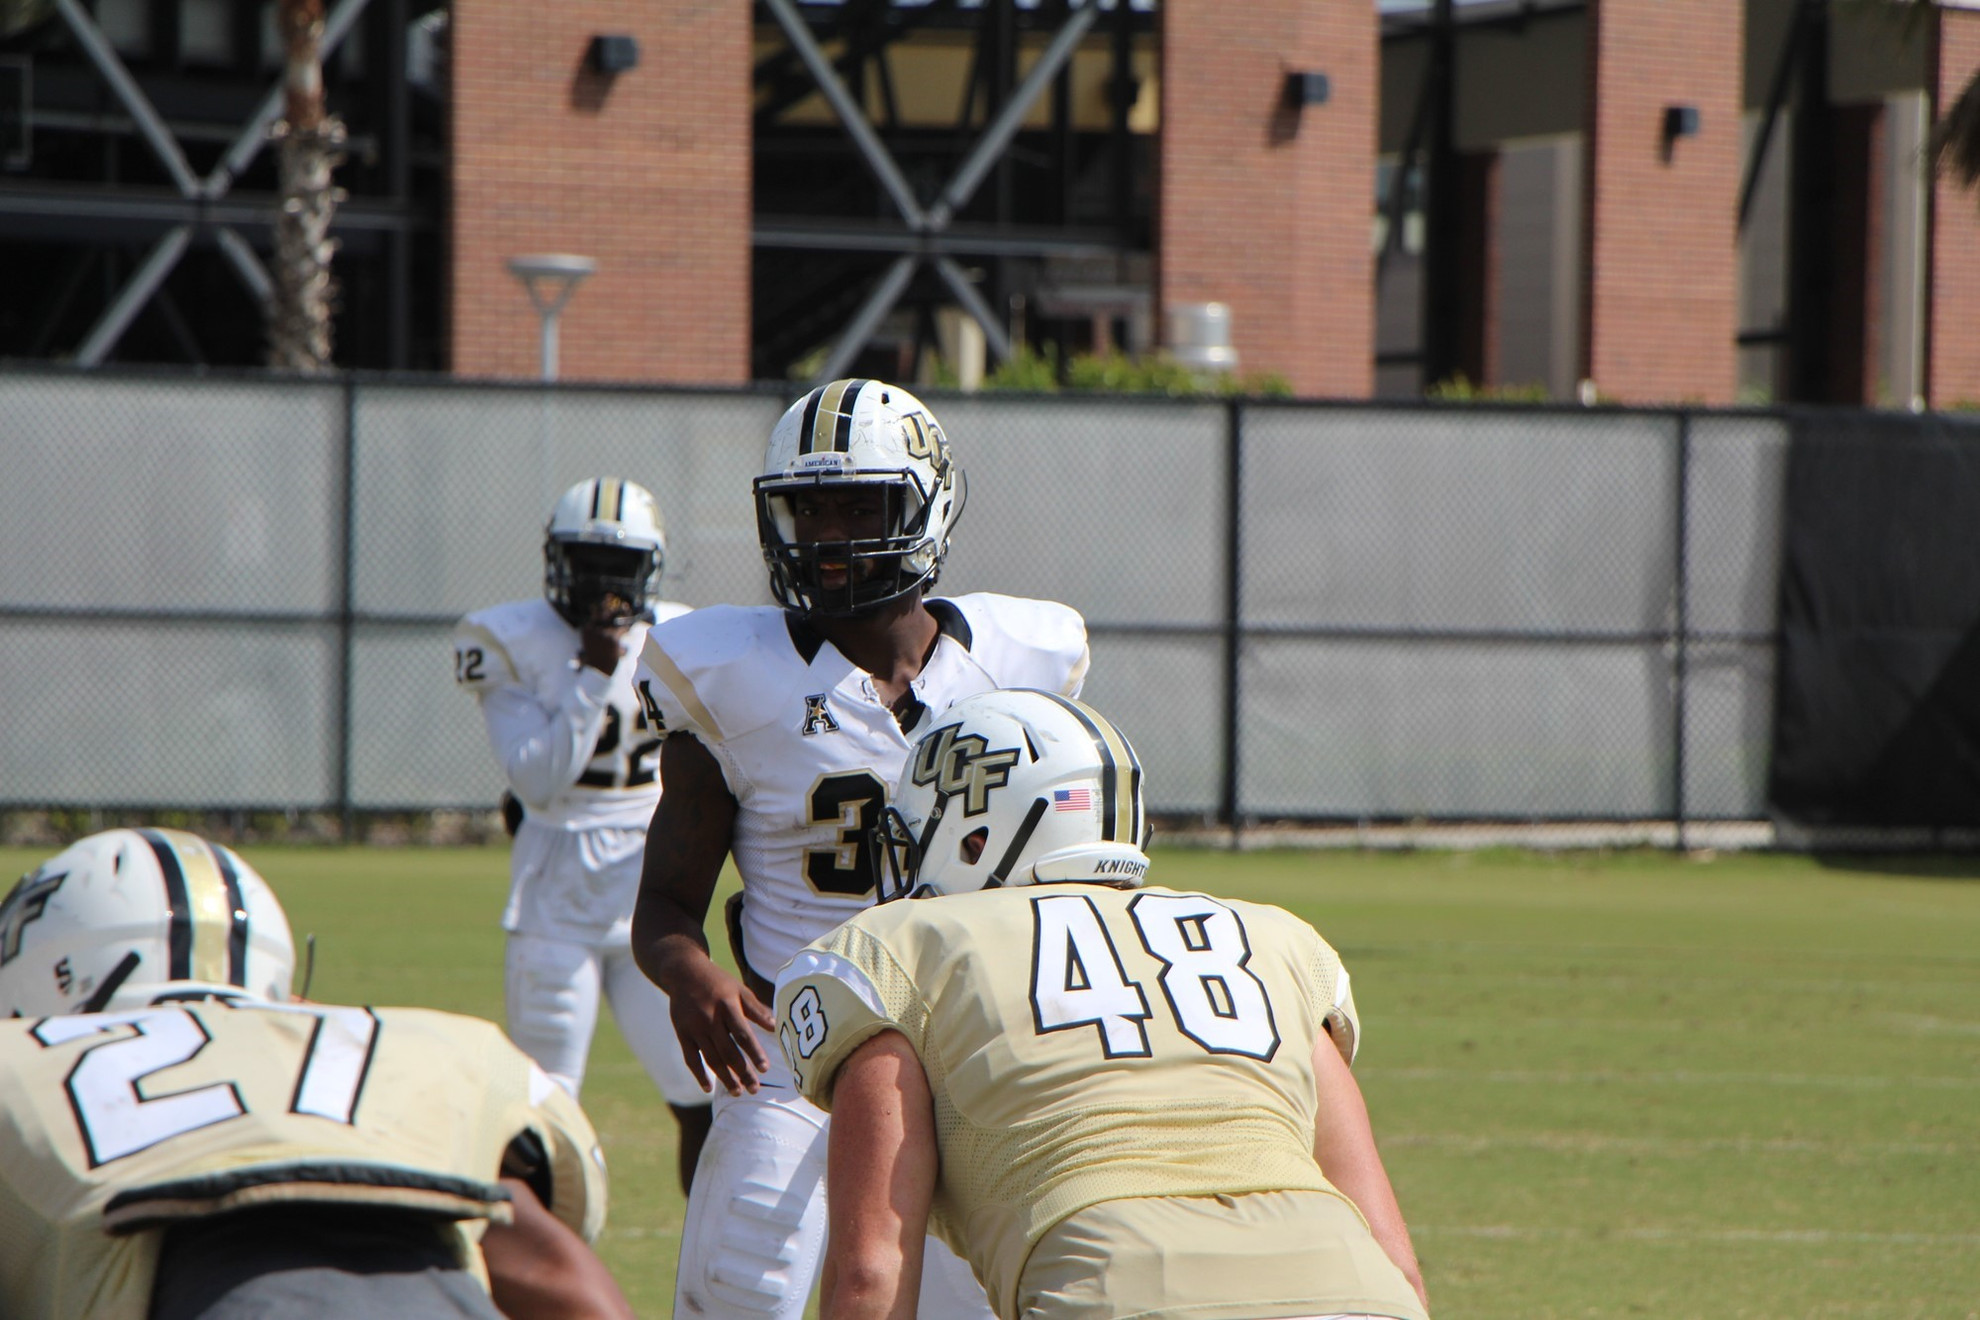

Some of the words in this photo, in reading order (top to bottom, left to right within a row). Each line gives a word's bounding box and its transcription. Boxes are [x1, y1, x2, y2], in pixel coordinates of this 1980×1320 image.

[801, 767, 909, 898] 3
[911, 722, 1021, 818] UCF
[1029, 893, 1282, 1063] 48
[27, 1001, 382, 1168] 27
